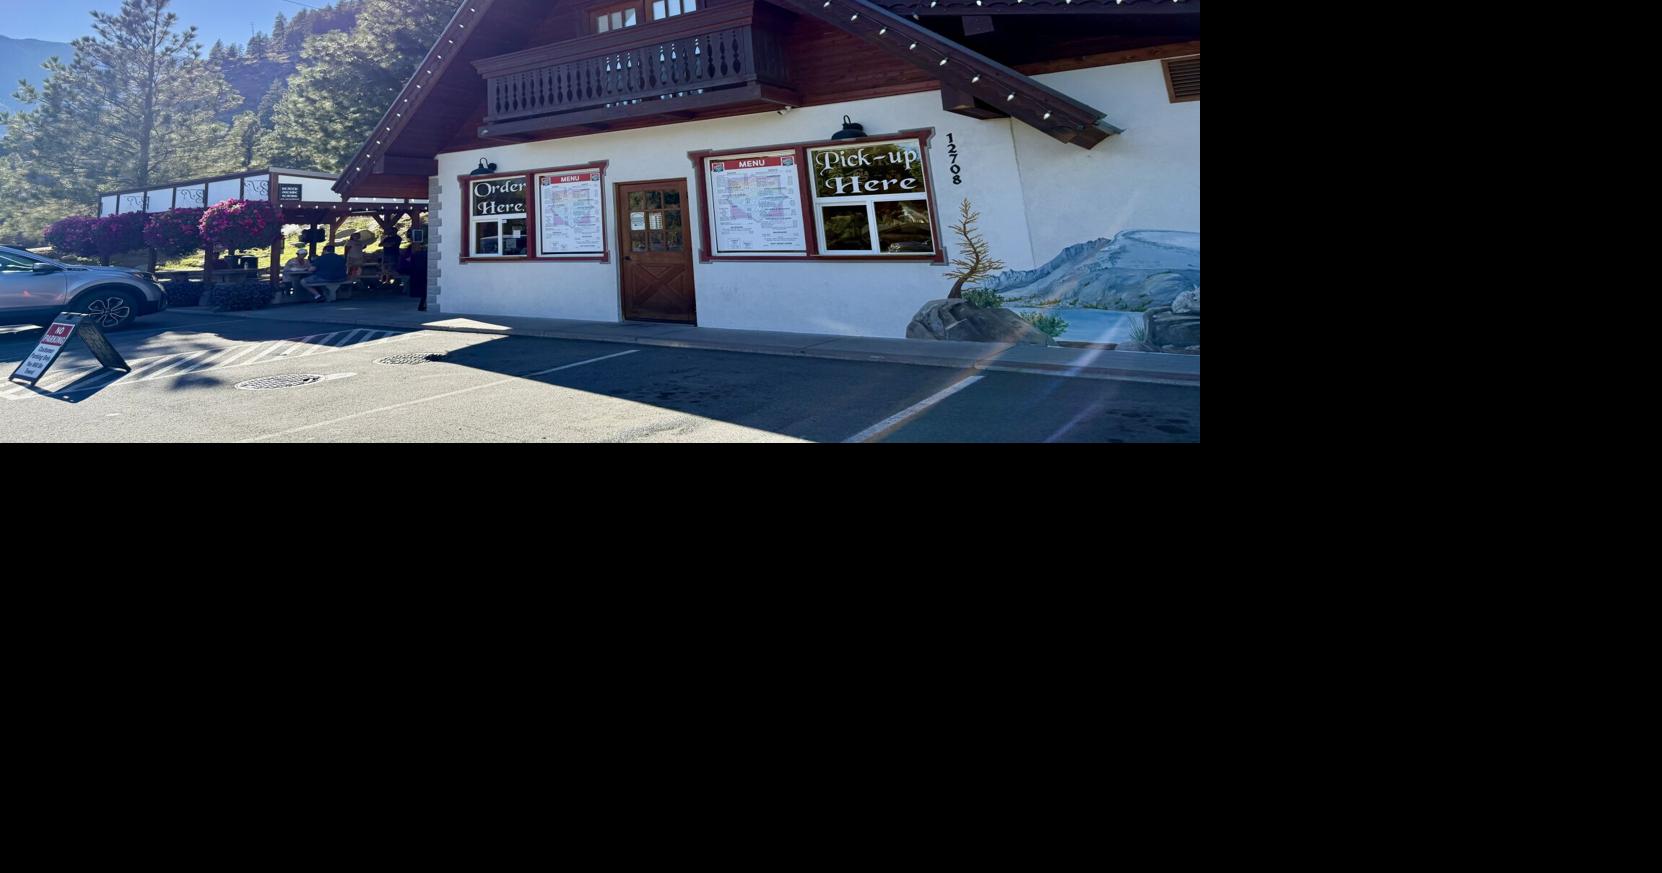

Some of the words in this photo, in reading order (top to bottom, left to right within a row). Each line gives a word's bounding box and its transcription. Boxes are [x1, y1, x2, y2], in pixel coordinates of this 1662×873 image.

[738, 159, 766, 168] MENU
[815, 149, 918, 176] Pick-up
[946, 132, 962, 186] 12708
[474, 180, 527, 198] Order
[825, 175, 917, 194] Here
[42, 334, 65, 344] PARKING
[55, 326, 64, 334] NO
